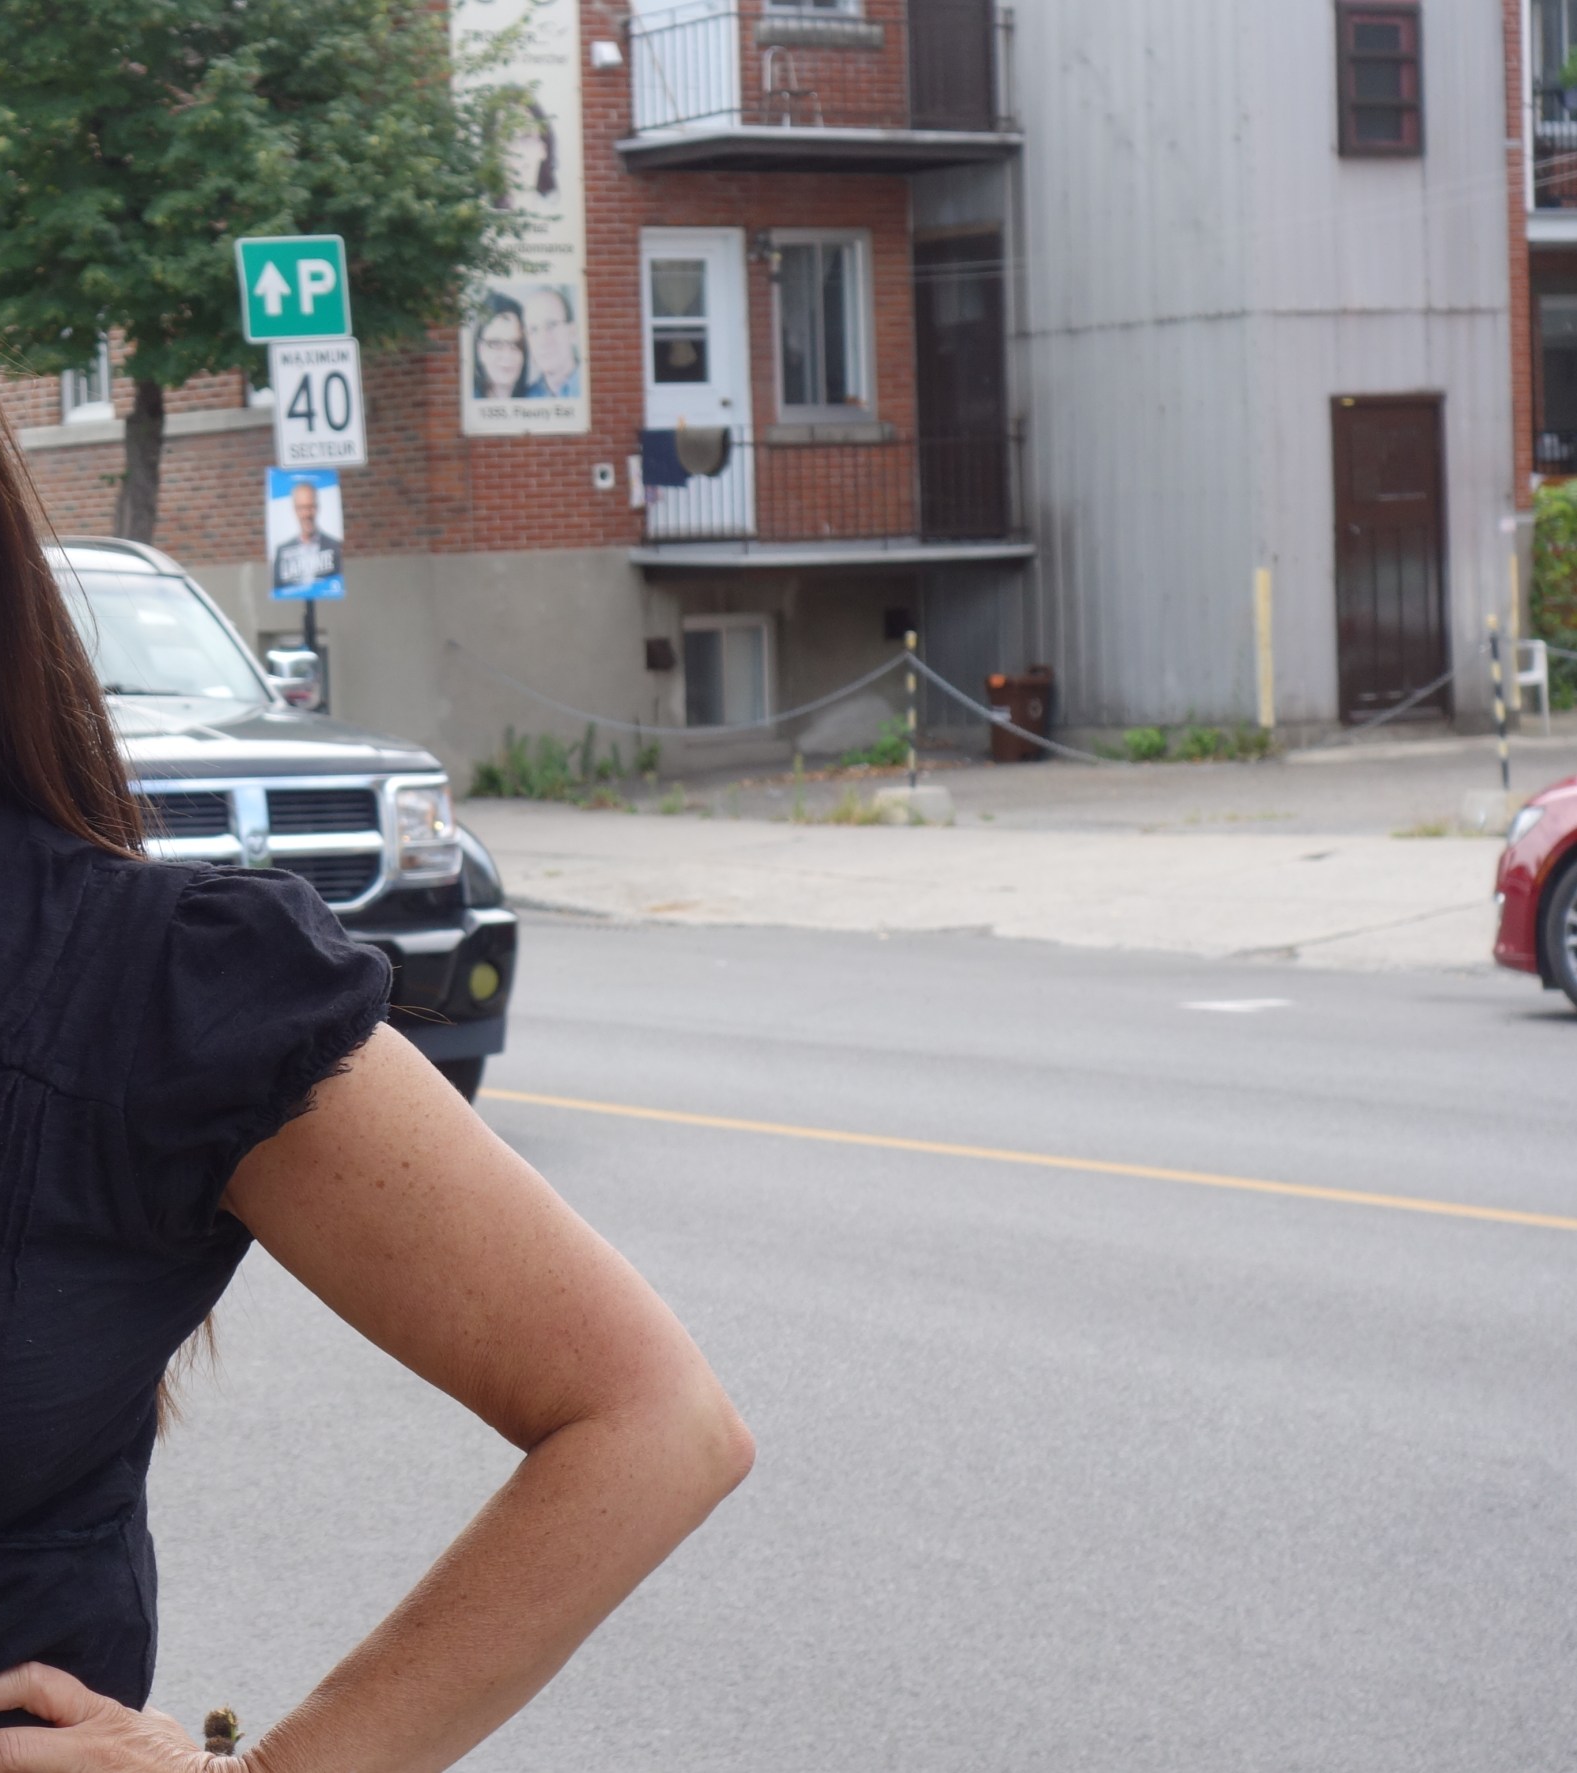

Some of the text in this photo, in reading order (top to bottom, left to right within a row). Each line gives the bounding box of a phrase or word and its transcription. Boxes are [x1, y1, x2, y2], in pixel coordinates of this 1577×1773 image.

[296, 259, 337, 316] P
[281, 350, 351, 366] MAXIMUM
[287, 371, 351, 433] 40
[290, 439, 358, 459] SECTEUR
